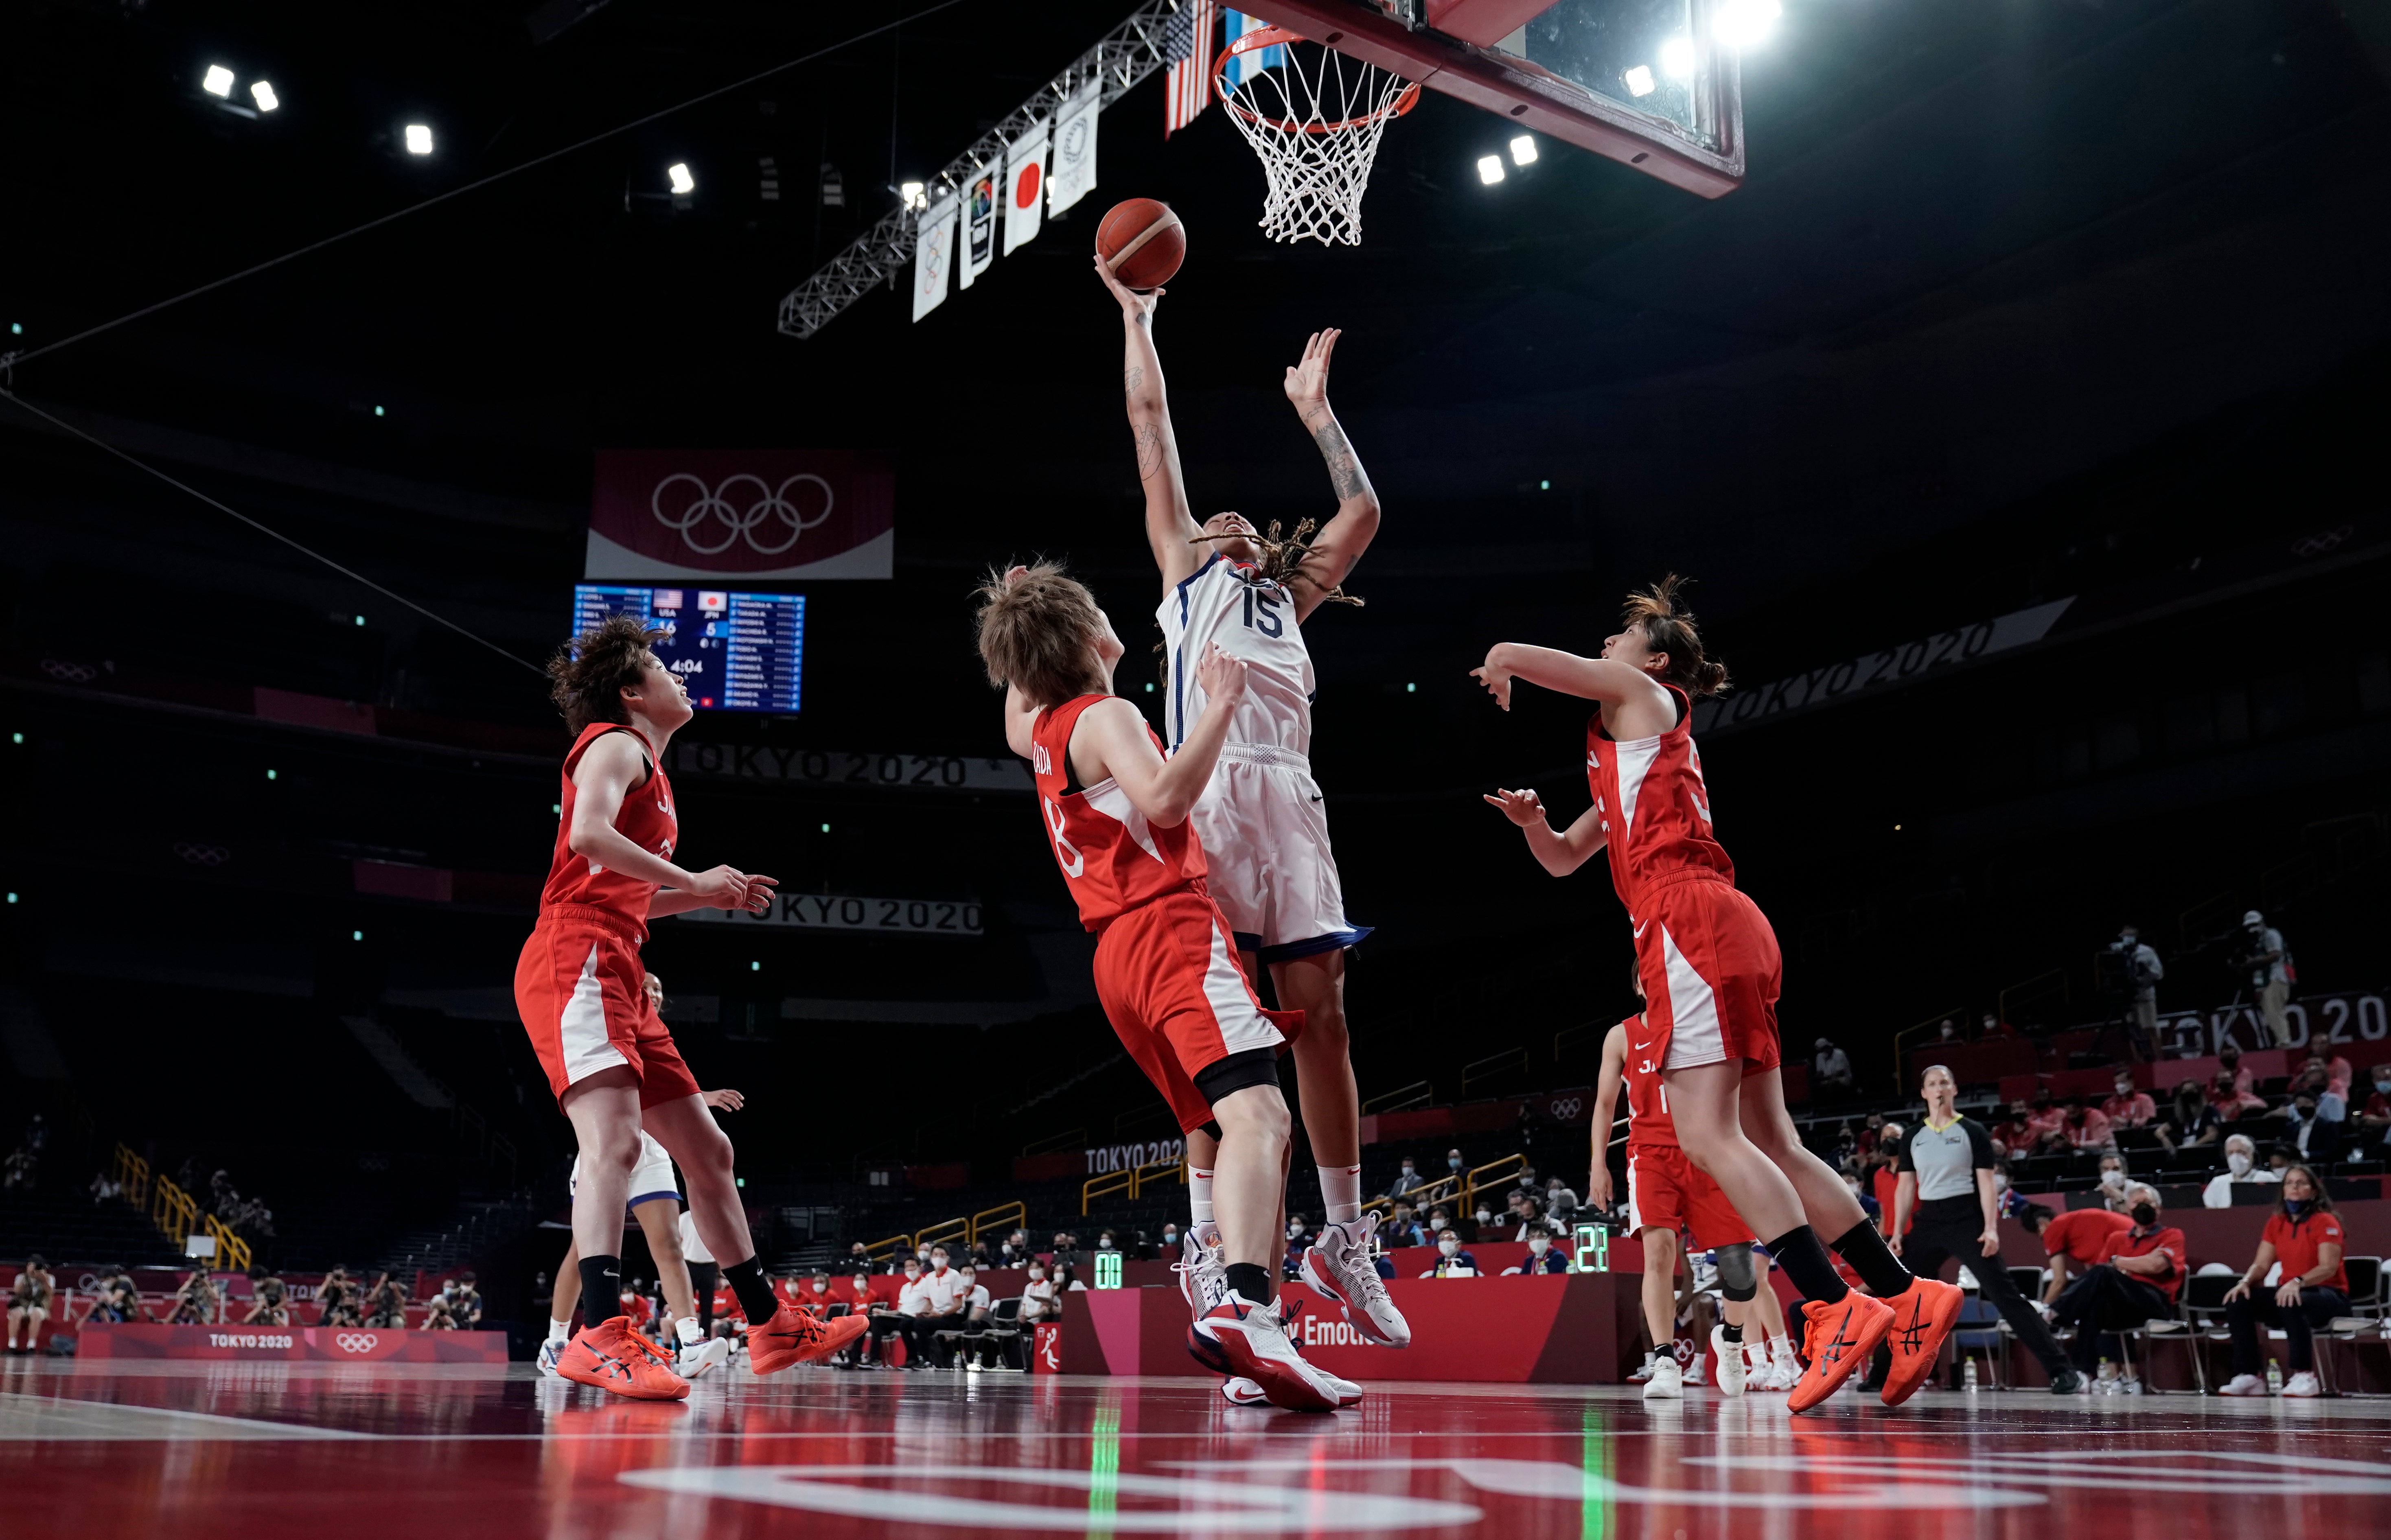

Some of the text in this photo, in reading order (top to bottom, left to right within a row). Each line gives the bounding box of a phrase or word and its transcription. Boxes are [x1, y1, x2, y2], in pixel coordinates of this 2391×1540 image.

[659, 620, 677, 635] 16
[1242, 586, 1283, 639] 15
[670, 658, 703, 674] 4:04
[1710, 619, 1995, 731] TOKYO 2020
[845, 751, 966, 786] 2020
[1044, 794, 1084, 879] 8
[879, 900, 983, 931] 2020
[1085, 1139, 1188, 1174] TOKYO 202
[1577, 1226, 1608, 1272] 22
[1096, 1253, 1121, 1289] 00
[209, 1334, 293, 1348] TOKYO 2020
